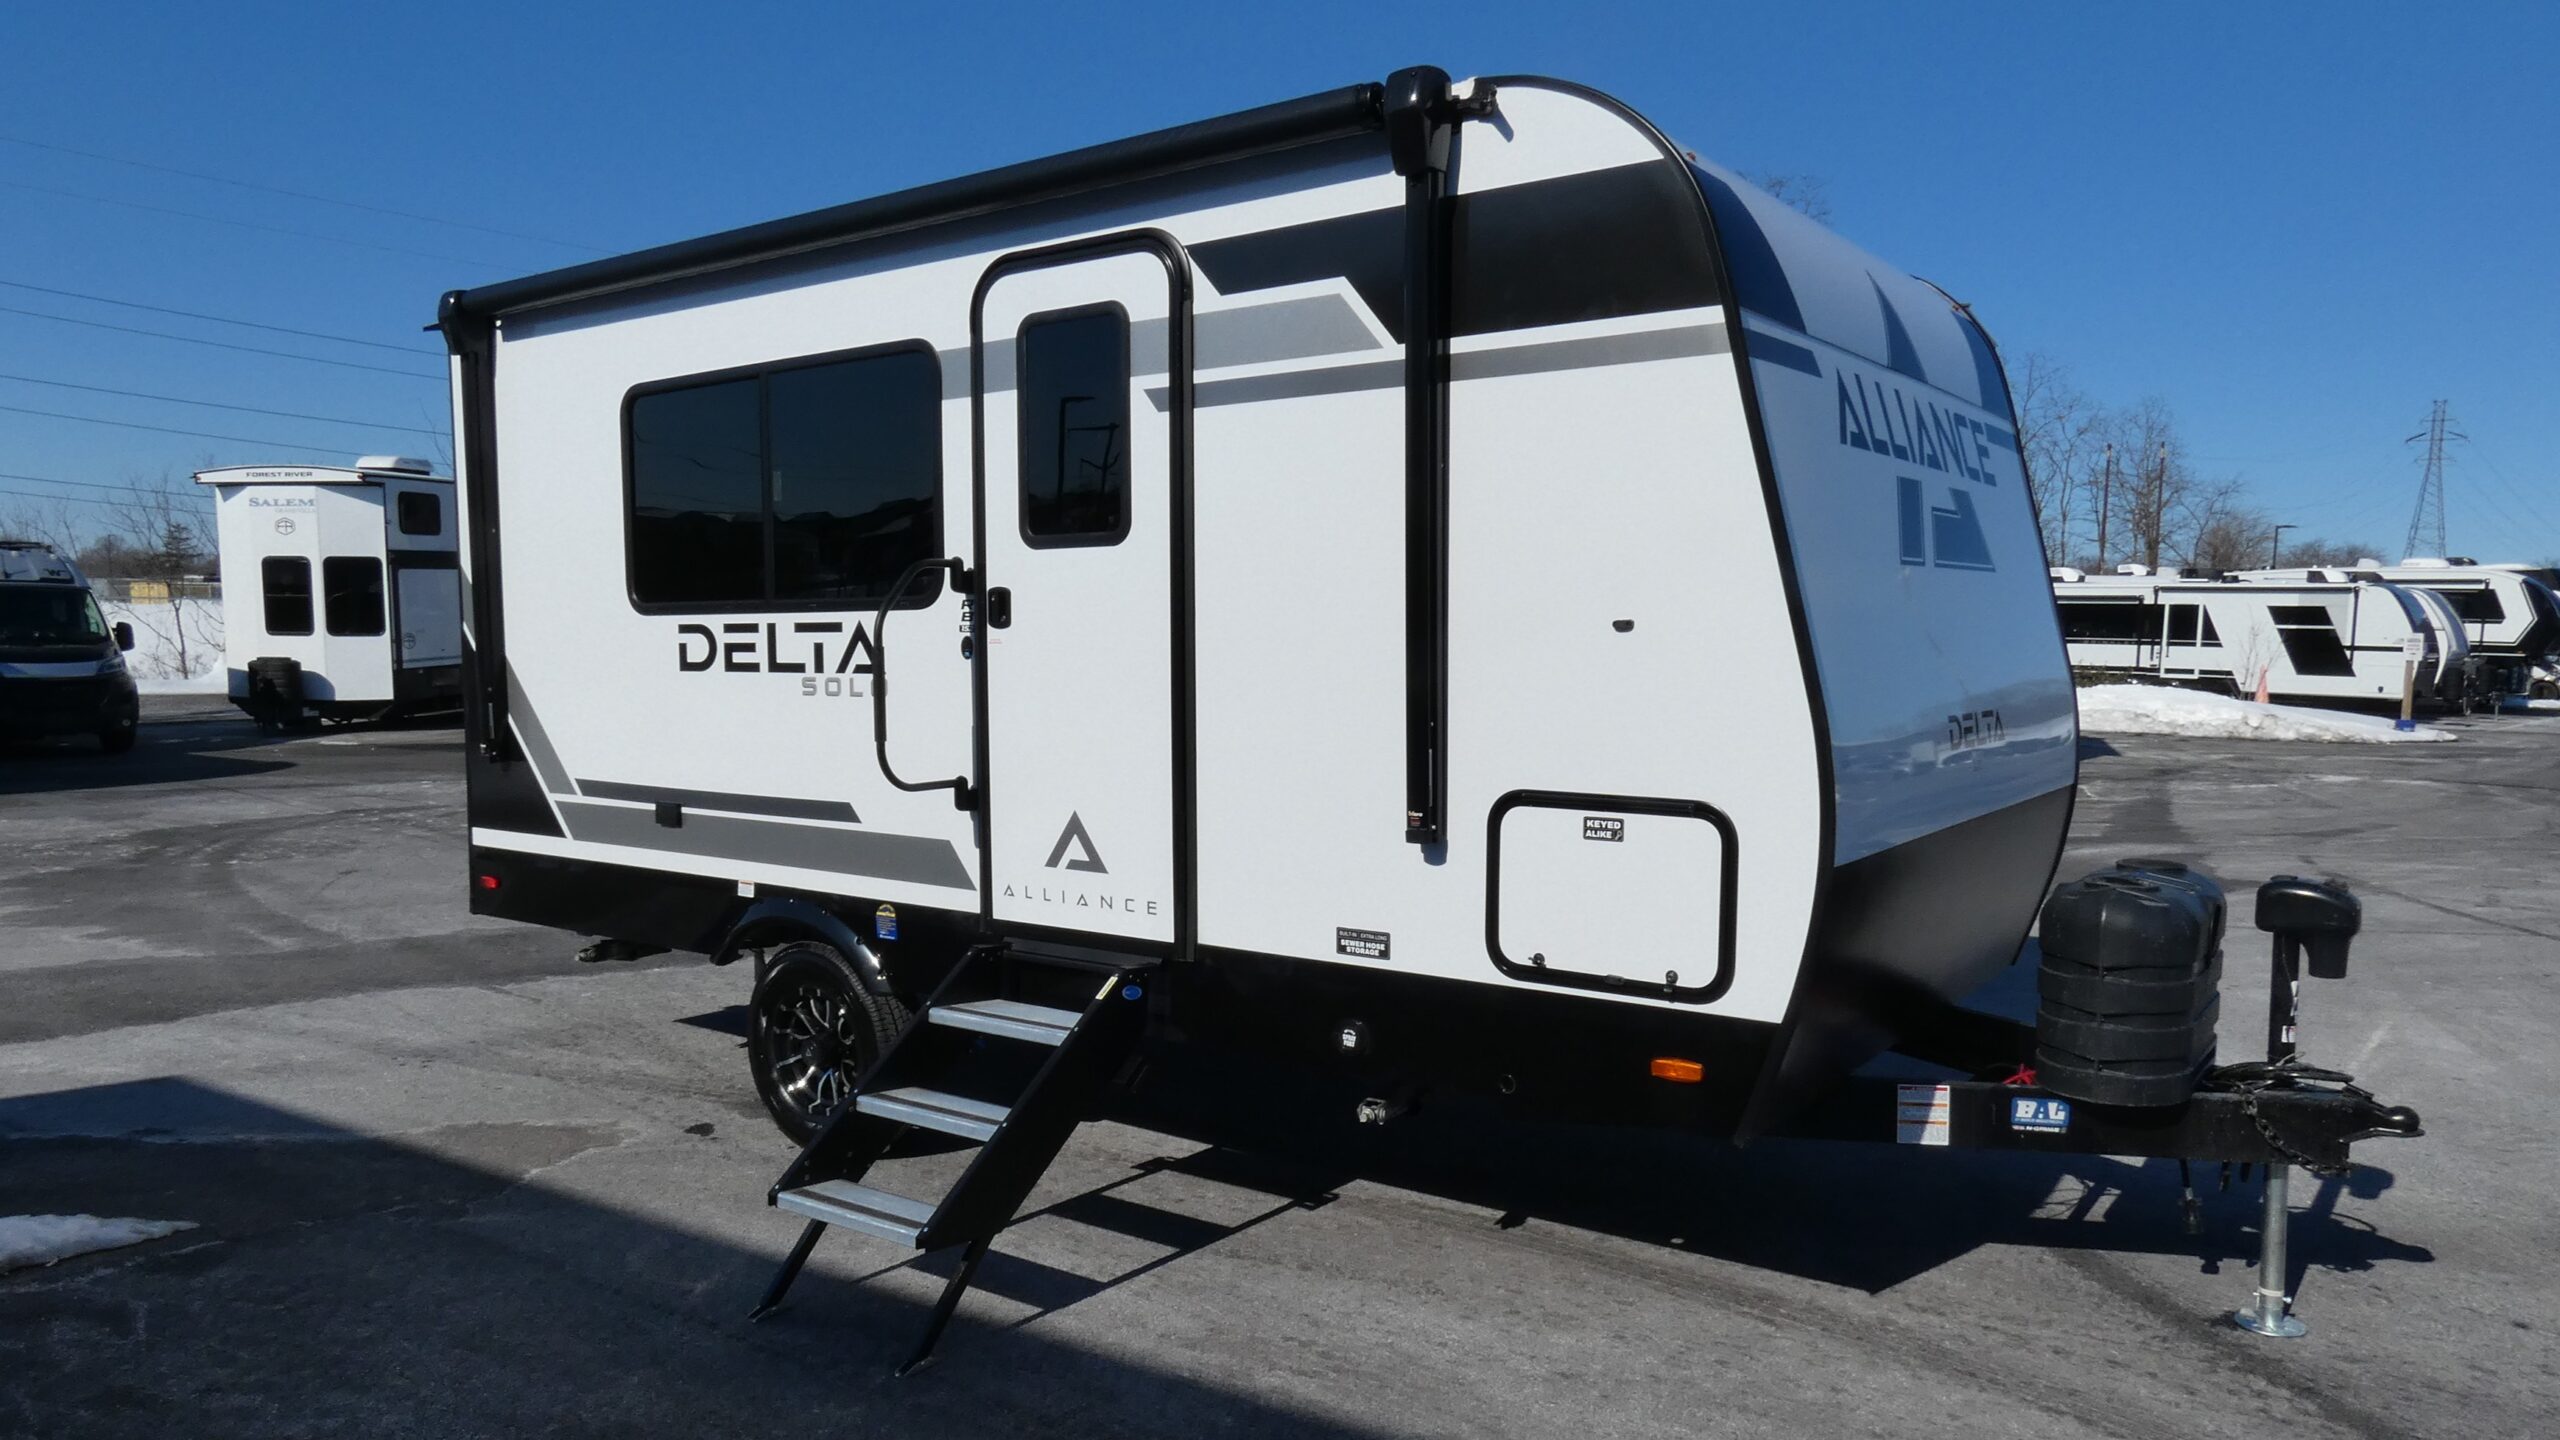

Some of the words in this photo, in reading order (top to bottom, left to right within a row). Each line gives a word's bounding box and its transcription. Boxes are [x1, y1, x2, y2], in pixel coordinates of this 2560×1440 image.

[1836, 367, 1998, 488] ALLIANCE
[248, 497, 315, 507] SALEM
[678, 619, 885, 675] DELTA
[1947, 708, 2006, 751] DELTA
[1586, 820, 1621, 829] KEYED
[1586, 830, 1612, 838] ALIKE
[1003, 883, 1158, 916] ALLIANCE
[1341, 939, 1364, 948] SEWER
[1366, 942, 1386, 950] HOSE
[1346, 946, 1380, 956] STORAGE
